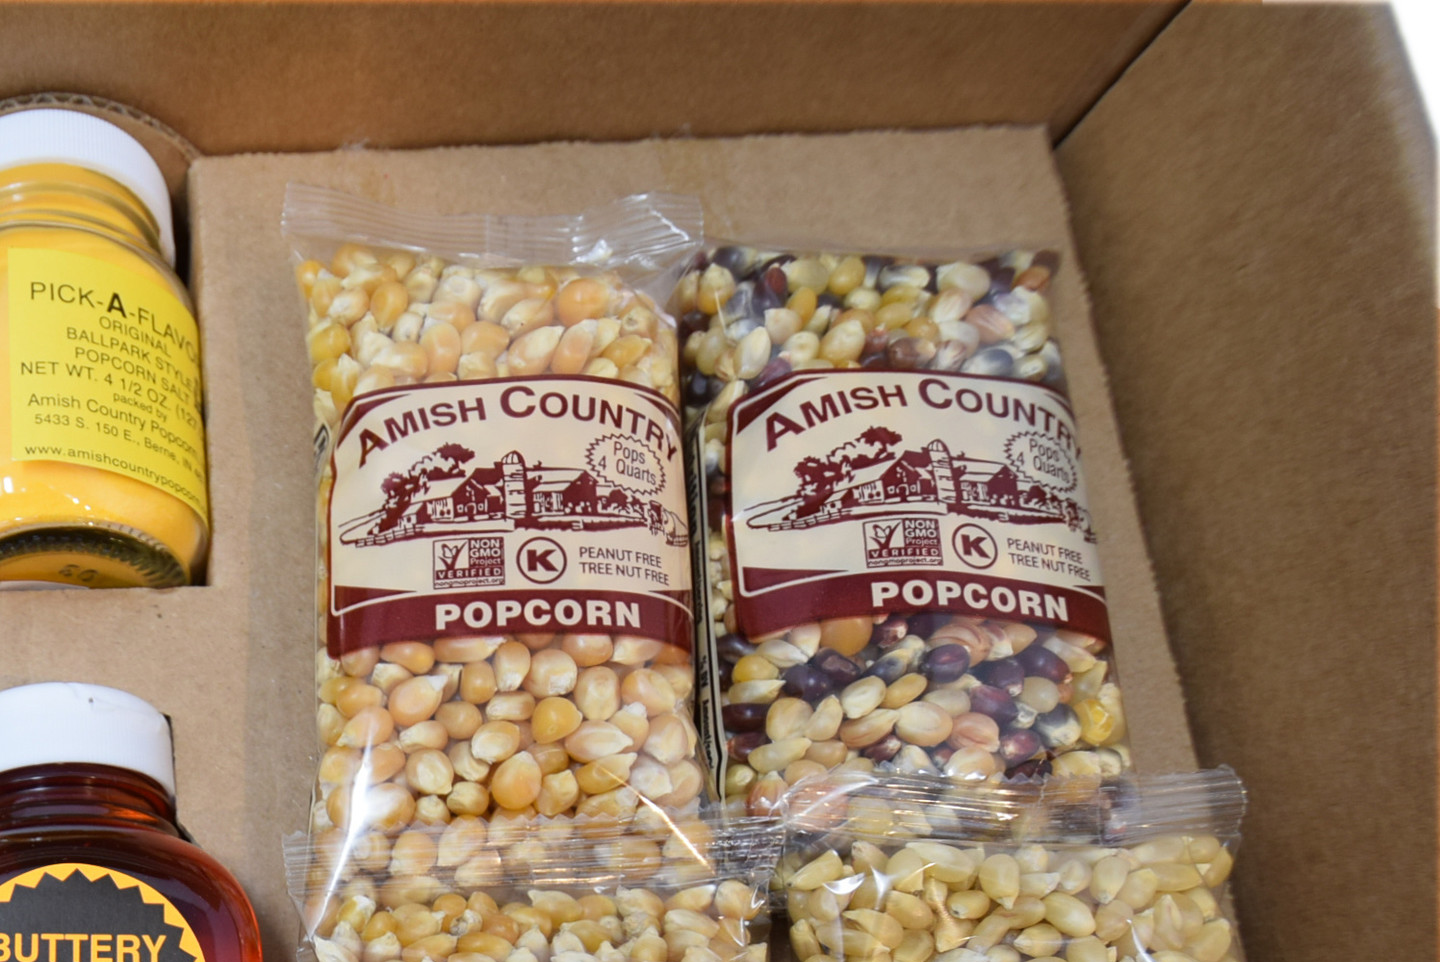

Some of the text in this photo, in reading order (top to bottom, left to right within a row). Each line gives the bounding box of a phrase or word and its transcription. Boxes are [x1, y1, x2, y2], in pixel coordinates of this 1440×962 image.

[67, 327, 151, 364] BALLPARK
[99, 316, 172, 357] ORIGINAL
[75, 348, 156, 385] POPCORN
[21, 362, 59, 375] NET
[66, 364, 98, 382] WT.
[104, 374, 113, 385] 4
[121, 378, 142, 396] 1/2
[147, 390, 171, 410] OZ.
[28, 393, 146, 431] Amish Country
[113, 392, 168, 423] packed by
[765, 379, 1082, 459] AMISH COUNTR
[34, 414, 70, 426] 5433
[76, 417, 89, 429] S.
[96, 422, 119, 437] 150
[359, 385, 677, 469] AMISH COUNTRY
[613, 441, 646, 465] Pops
[1016, 452, 1025, 465] 4
[598, 457, 657, 485] 4 Quarts
[905, 520, 935, 529] NON
[905, 528, 937, 538] GMO
[470, 548, 501, 558] GMO
[471, 539, 500, 549] NON
[871, 547, 939, 557] VERIFIED
[961, 534, 991, 559] K
[1007, 538, 1083, 564] PEANUT FREE
[527, 549, 559, 572] K
[579, 547, 662, 568] PEANUT FREE
[1009, 553, 1091, 582] TREE NUT FREE
[438, 567, 501, 579] VERIFIED
[579, 562, 669, 585] TREE NUT FREE
[871, 580, 1069, 622] POPCORN
[435, 599, 641, 630] POPCORN
